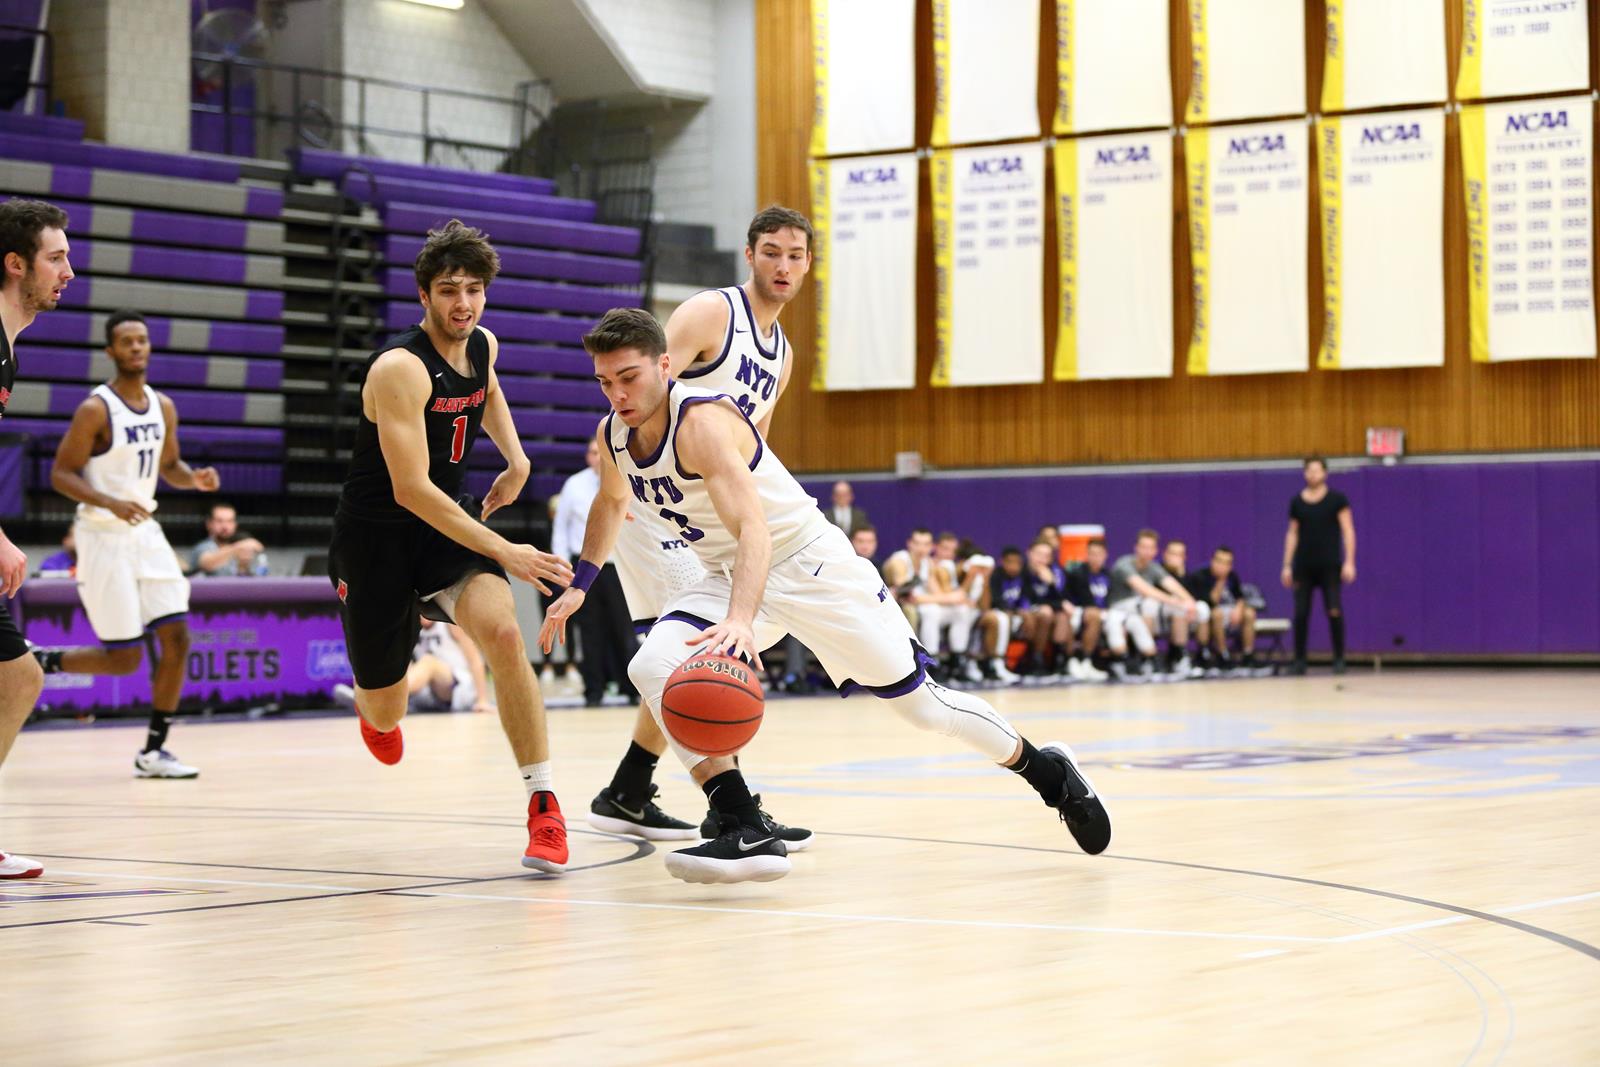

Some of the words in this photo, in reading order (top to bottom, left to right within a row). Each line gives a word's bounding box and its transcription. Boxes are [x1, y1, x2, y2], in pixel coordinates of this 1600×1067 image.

[1505, 110, 1567, 132] NCAA
[1227, 134, 1285, 156] NCAA
[1361, 123, 1420, 144] NCAA
[970, 156, 1022, 176] NCAA
[1095, 146, 1150, 167] NCAA
[847, 166, 896, 187] NCAA
[734, 353, 777, 402] NYU
[125, 422, 160, 444] NYU
[450, 415, 468, 464] 1
[138, 448, 154, 478] 11
[627, 473, 684, 506] NYU
[659, 507, 705, 542] 3
[187, 649, 281, 682] OLETS
[682, 660, 749, 686] Wilson
